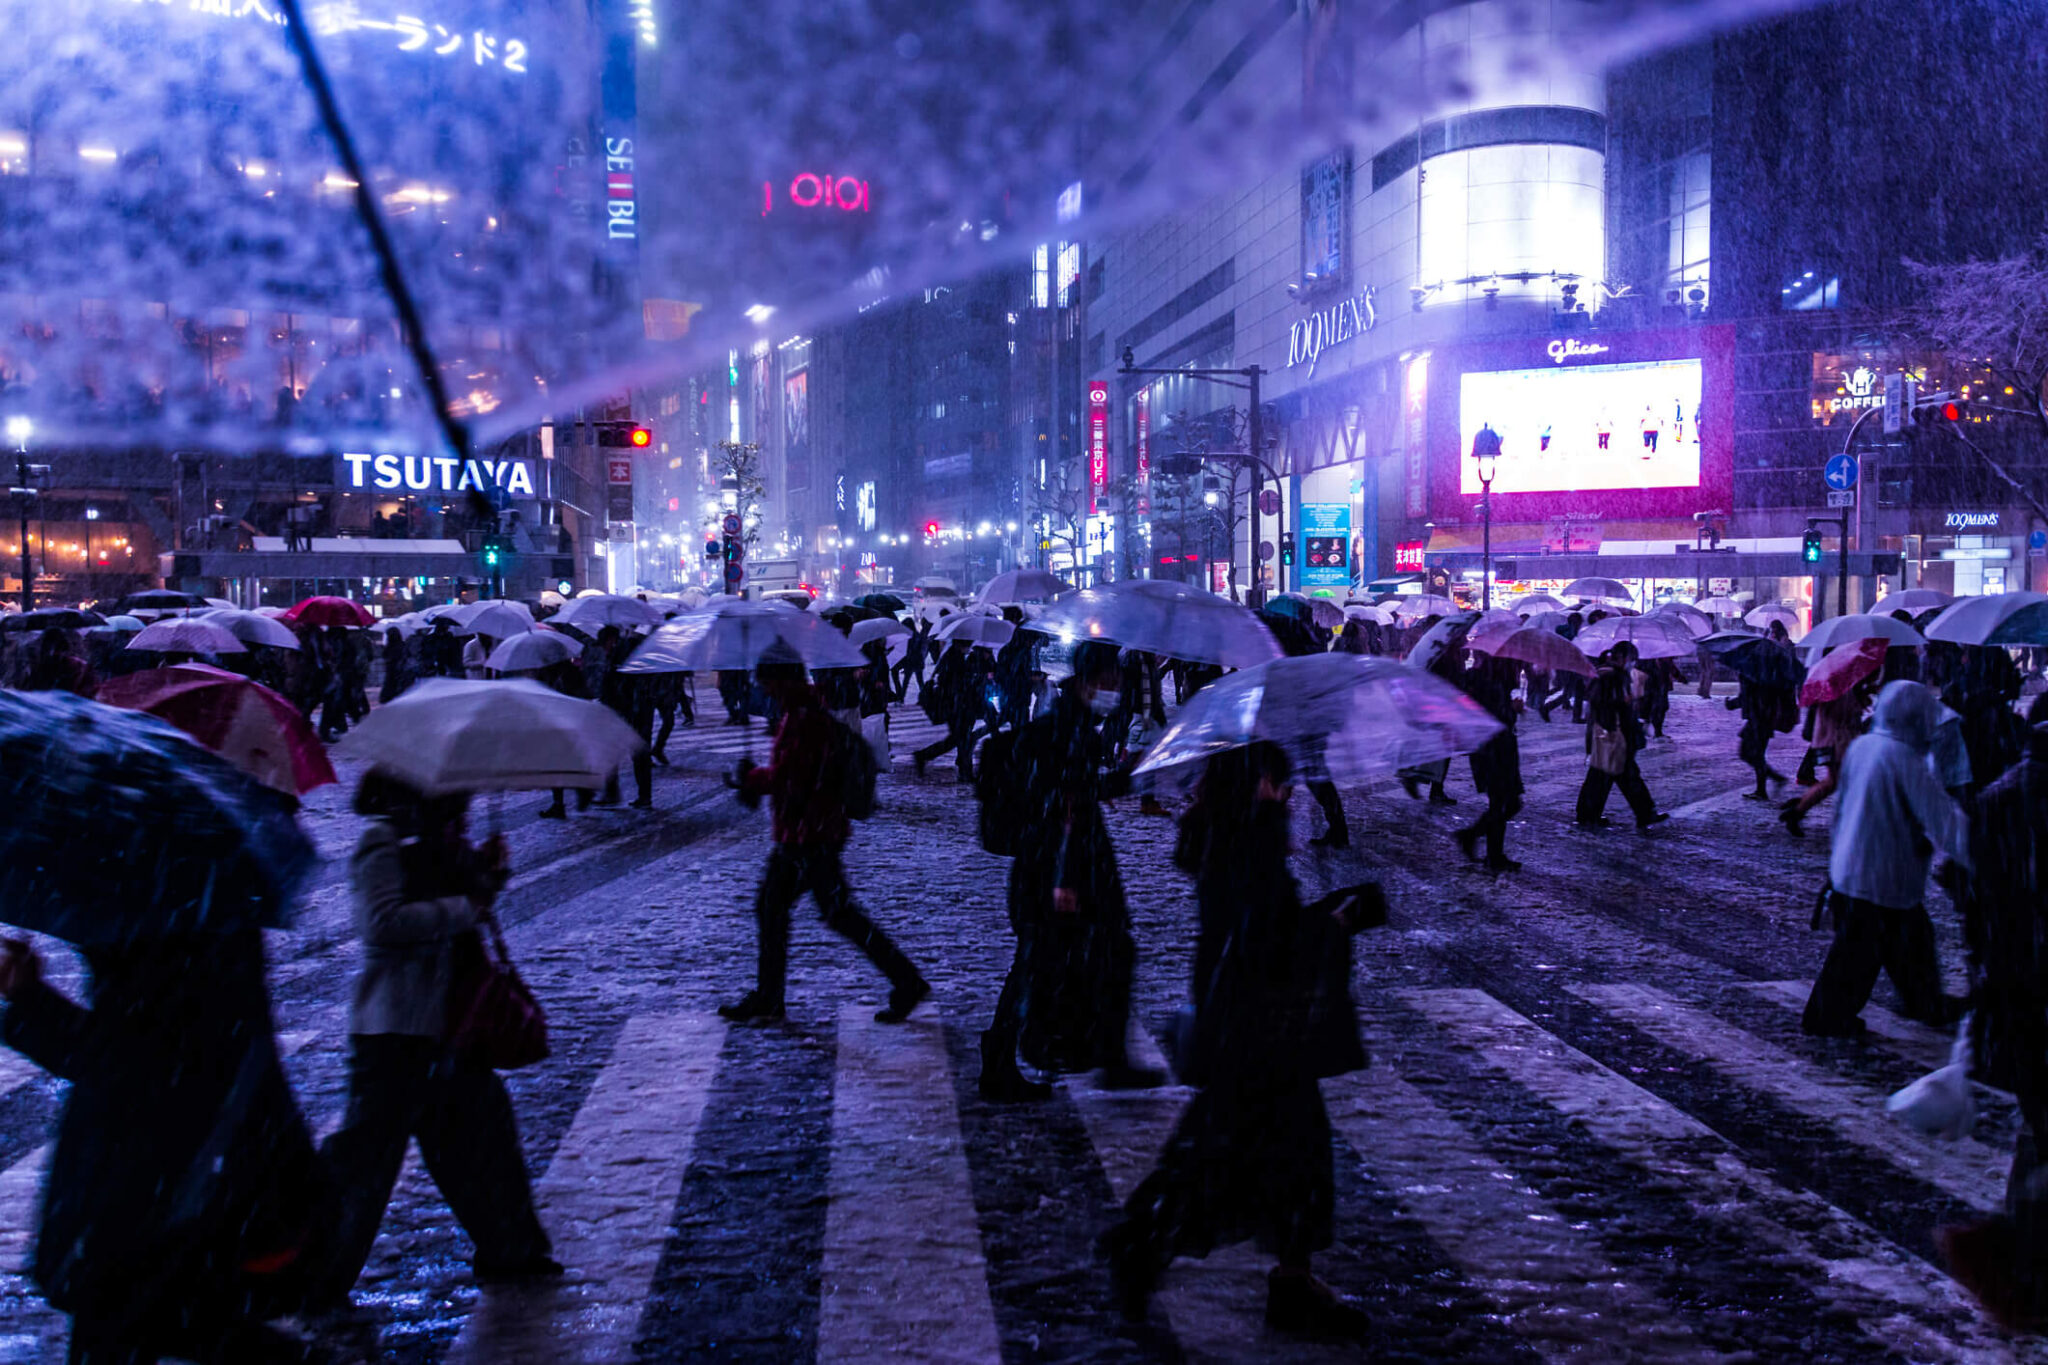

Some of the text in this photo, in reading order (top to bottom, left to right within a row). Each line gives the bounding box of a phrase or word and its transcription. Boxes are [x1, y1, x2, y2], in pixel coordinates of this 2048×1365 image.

[606, 137, 636, 240] SEIBU
[1547, 338, 1609, 364] Glico
[343, 452, 534, 495] TSUTAYA
